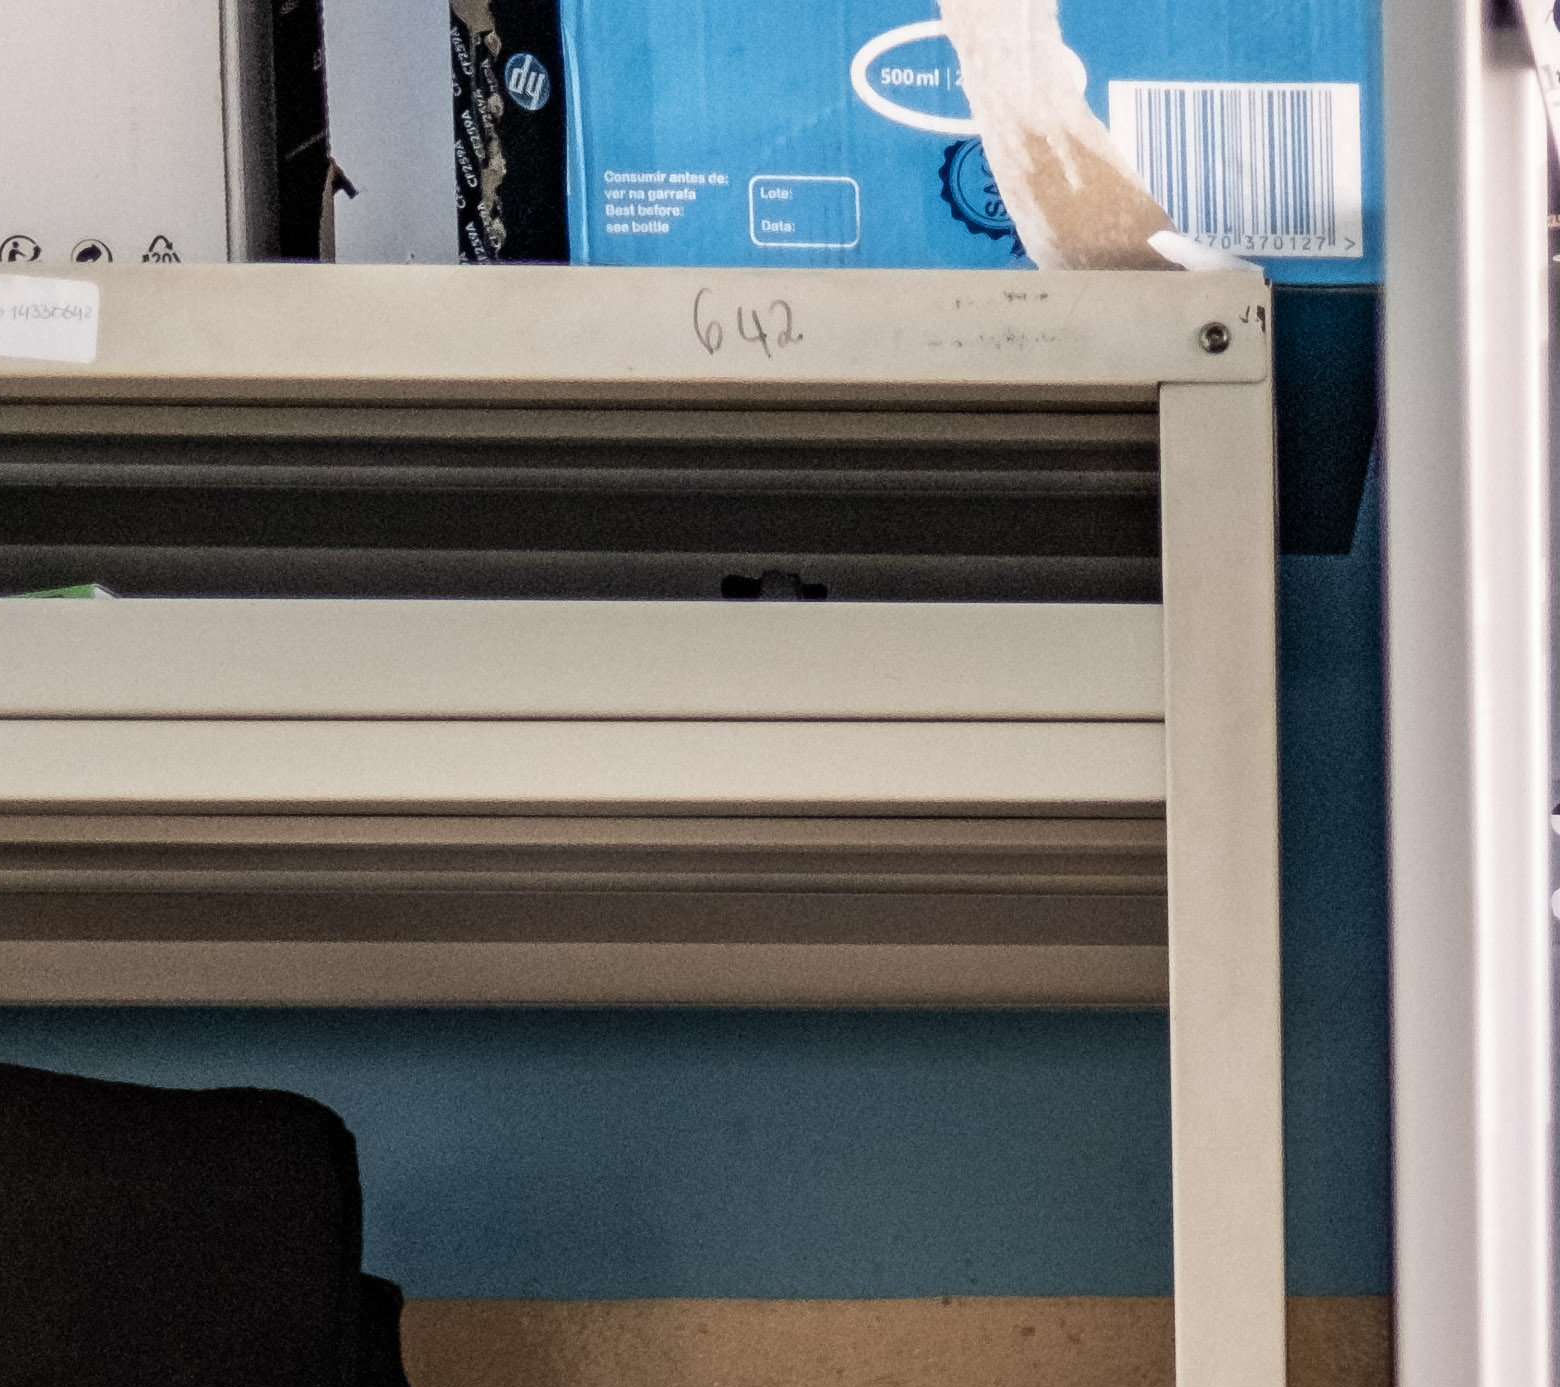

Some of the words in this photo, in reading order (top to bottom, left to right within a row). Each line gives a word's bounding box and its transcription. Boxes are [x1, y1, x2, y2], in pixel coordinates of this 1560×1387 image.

[604, 170, 667, 184] Consumir
[669, 172, 705, 185] antes
[604, 189, 627, 200] ver
[628, 189, 645, 200] na
[648, 187, 697, 202] garrafa
[605, 203, 635, 217] Best
[1244, 235, 1327, 252] 370127
[694, 286, 805, 359] 642
